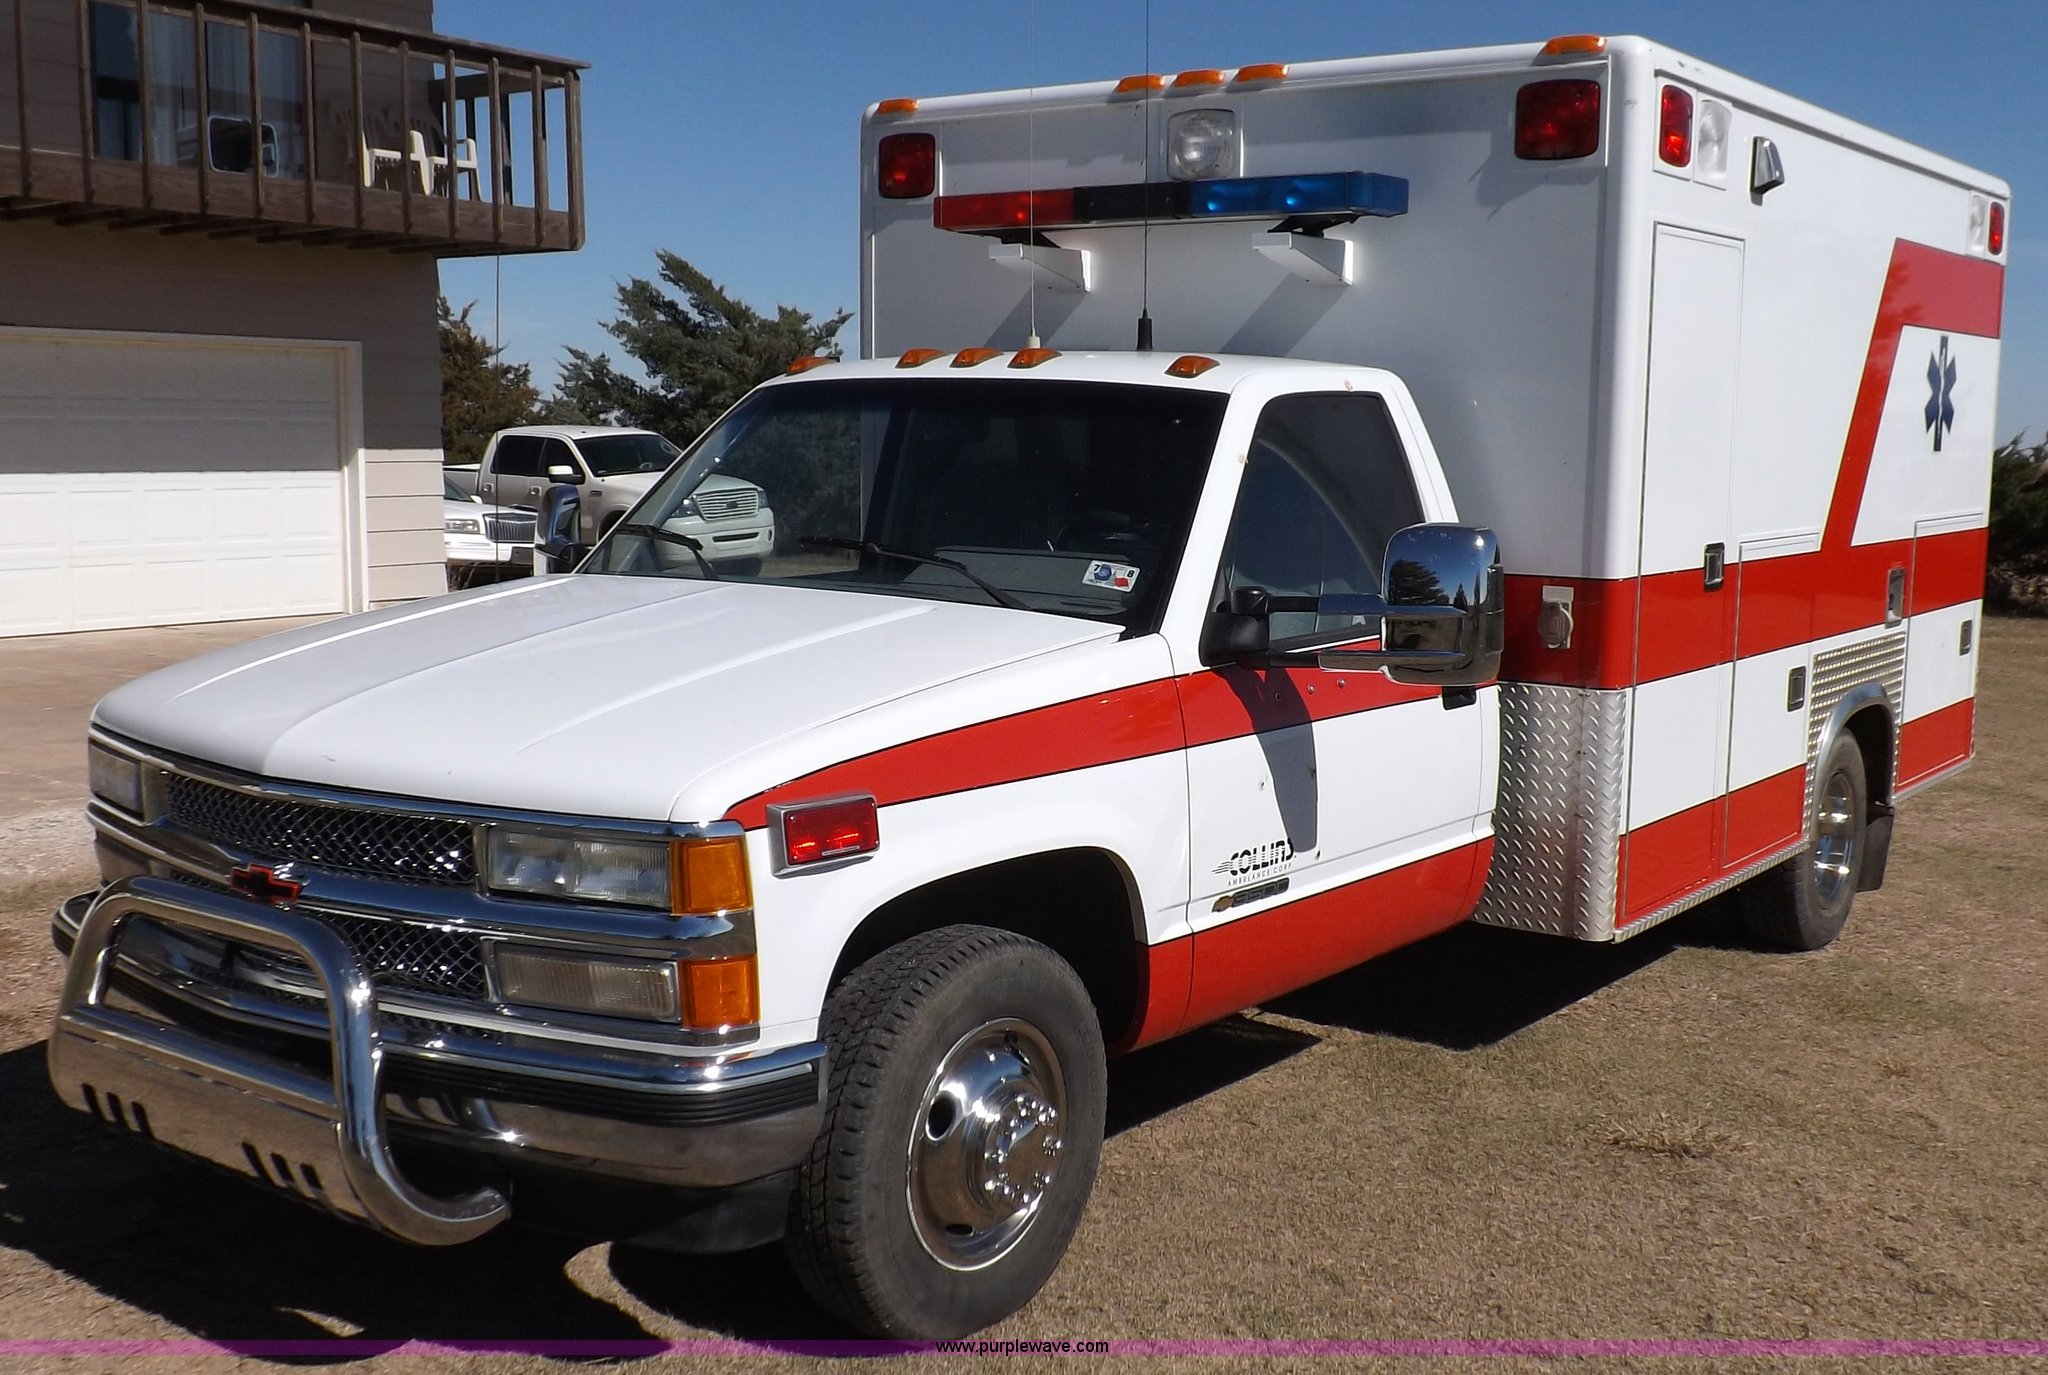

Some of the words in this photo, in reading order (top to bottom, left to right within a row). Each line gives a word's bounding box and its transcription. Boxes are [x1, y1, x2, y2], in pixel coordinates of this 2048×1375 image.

[1093, 564, 1101, 572] 7
[1127, 570, 1135, 578] 8
[1228, 870, 1269, 886] AMBULANCE
